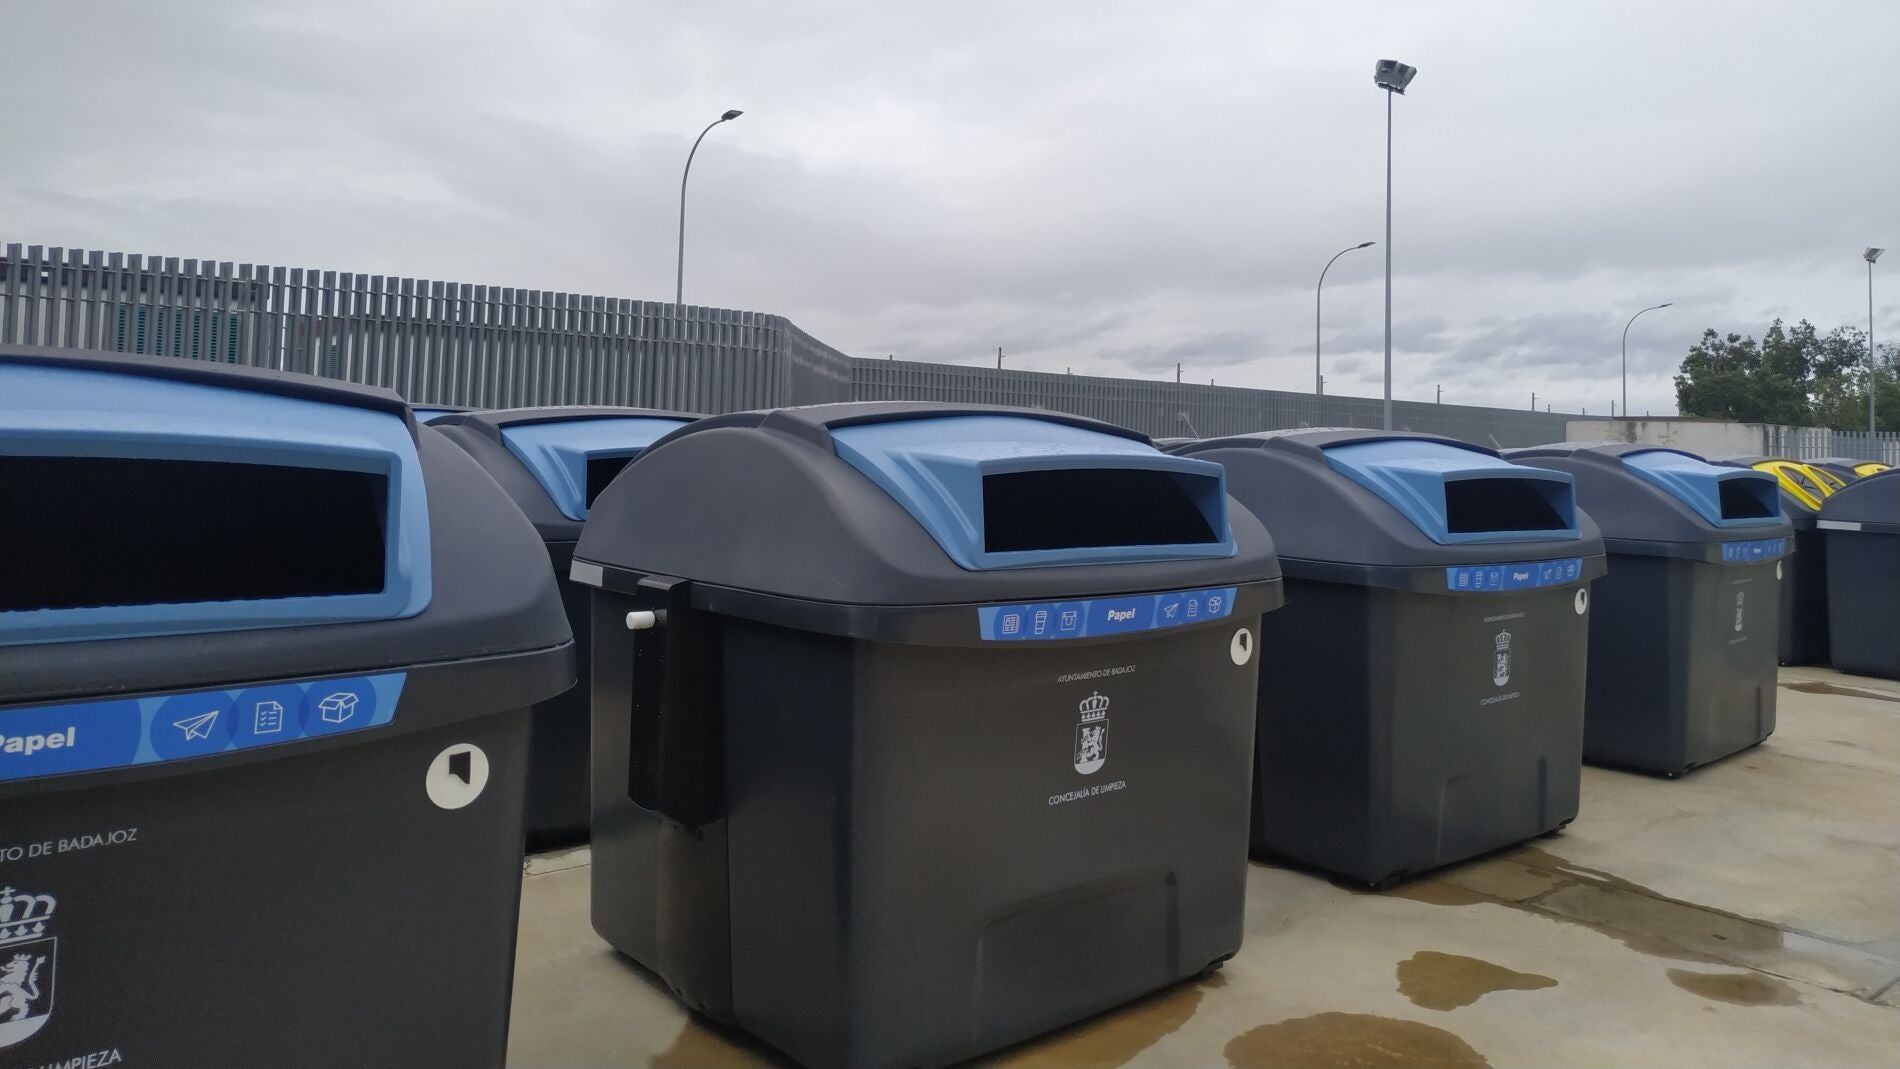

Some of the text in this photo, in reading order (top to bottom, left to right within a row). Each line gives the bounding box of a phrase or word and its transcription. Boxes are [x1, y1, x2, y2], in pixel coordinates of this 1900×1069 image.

[1513, 571, 1529, 581] Papel
[1107, 607, 1136, 622] Papel
[1057, 664, 1136, 683] AYUNTAMIENTO DE BADAJOZ
[0, 726, 76, 756] apel
[1048, 780, 1126, 806] CONCEJALÍA DE LIMPIEZA
[28, 841, 53, 858] DE
[58, 827, 138, 853] BADAJOZ
[40, 1048, 122, 1069] MPIEZA
